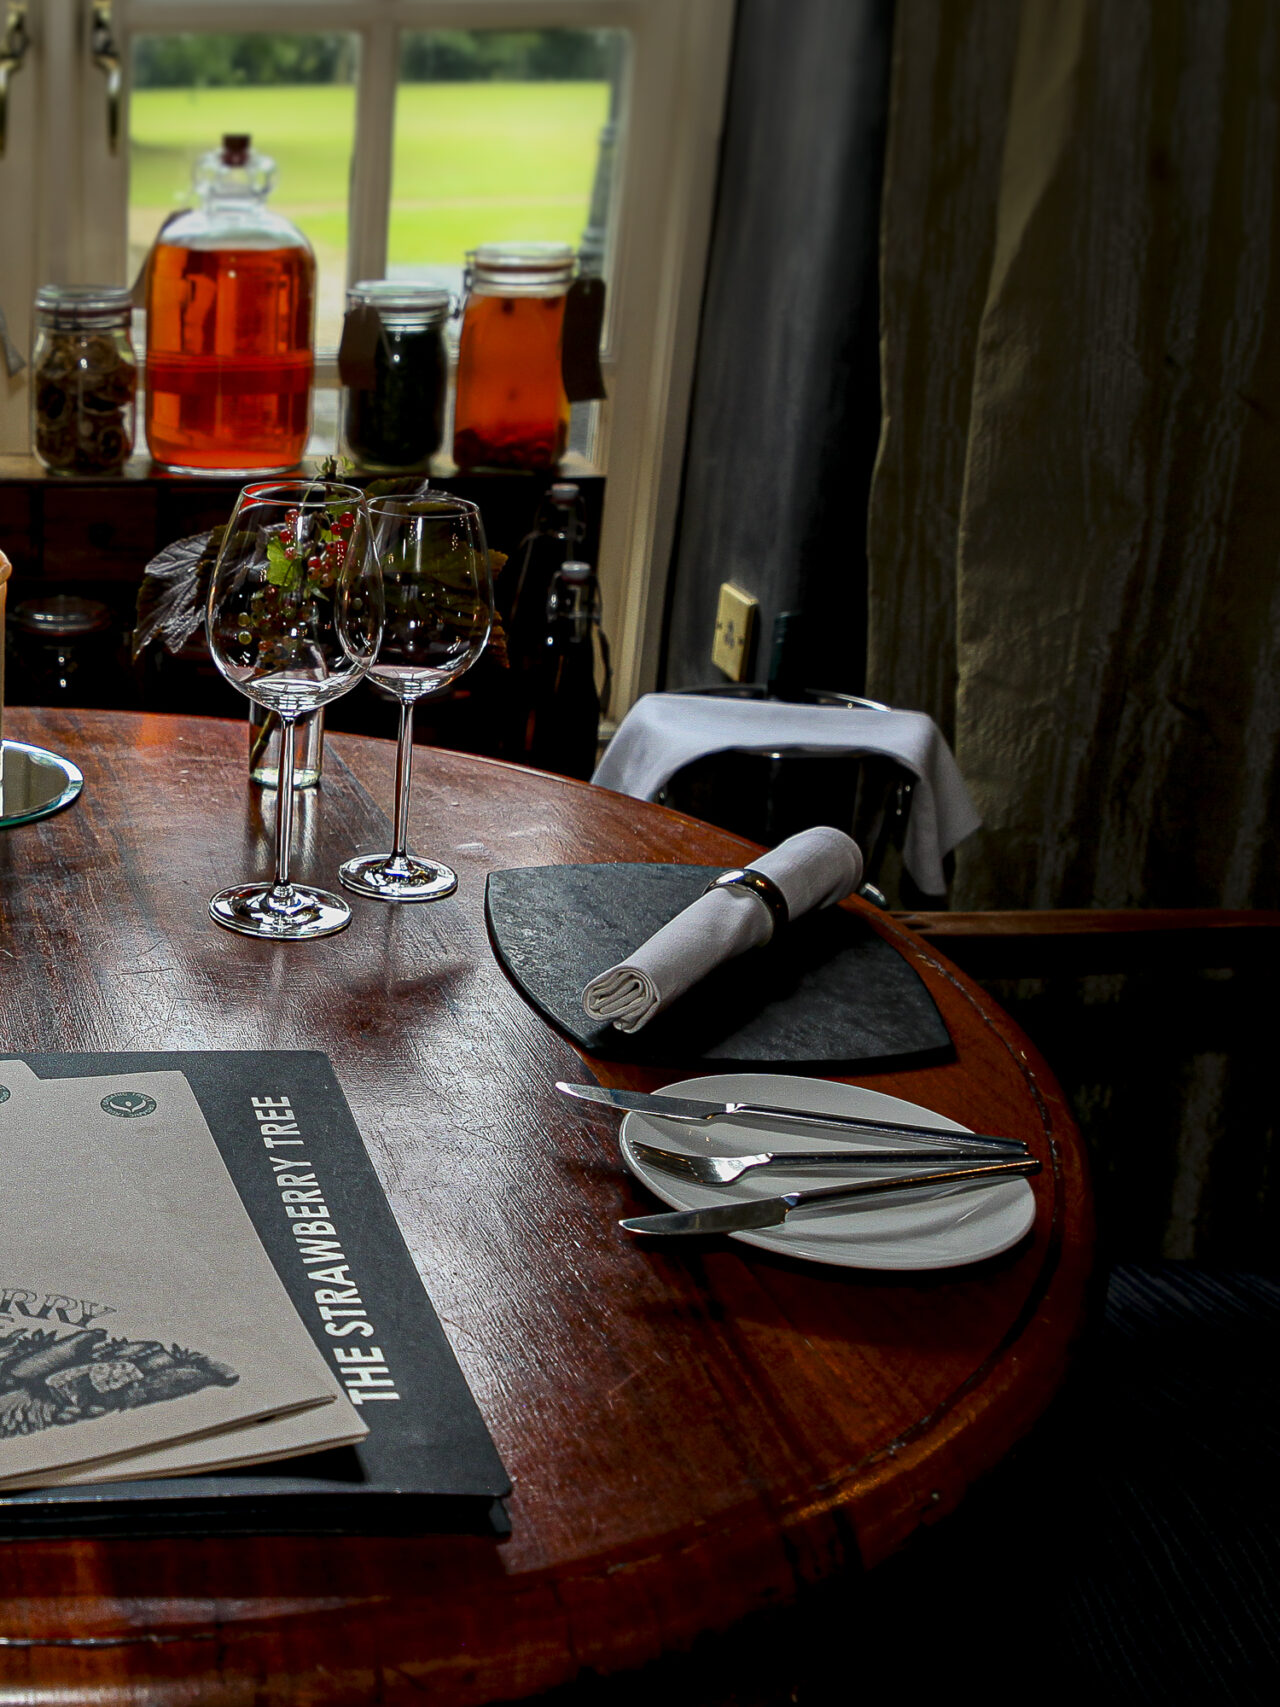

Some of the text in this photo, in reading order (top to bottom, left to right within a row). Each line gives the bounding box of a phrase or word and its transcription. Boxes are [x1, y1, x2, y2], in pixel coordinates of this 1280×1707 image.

[251, 1096, 400, 1405] THE STRAWBERRY TREE
